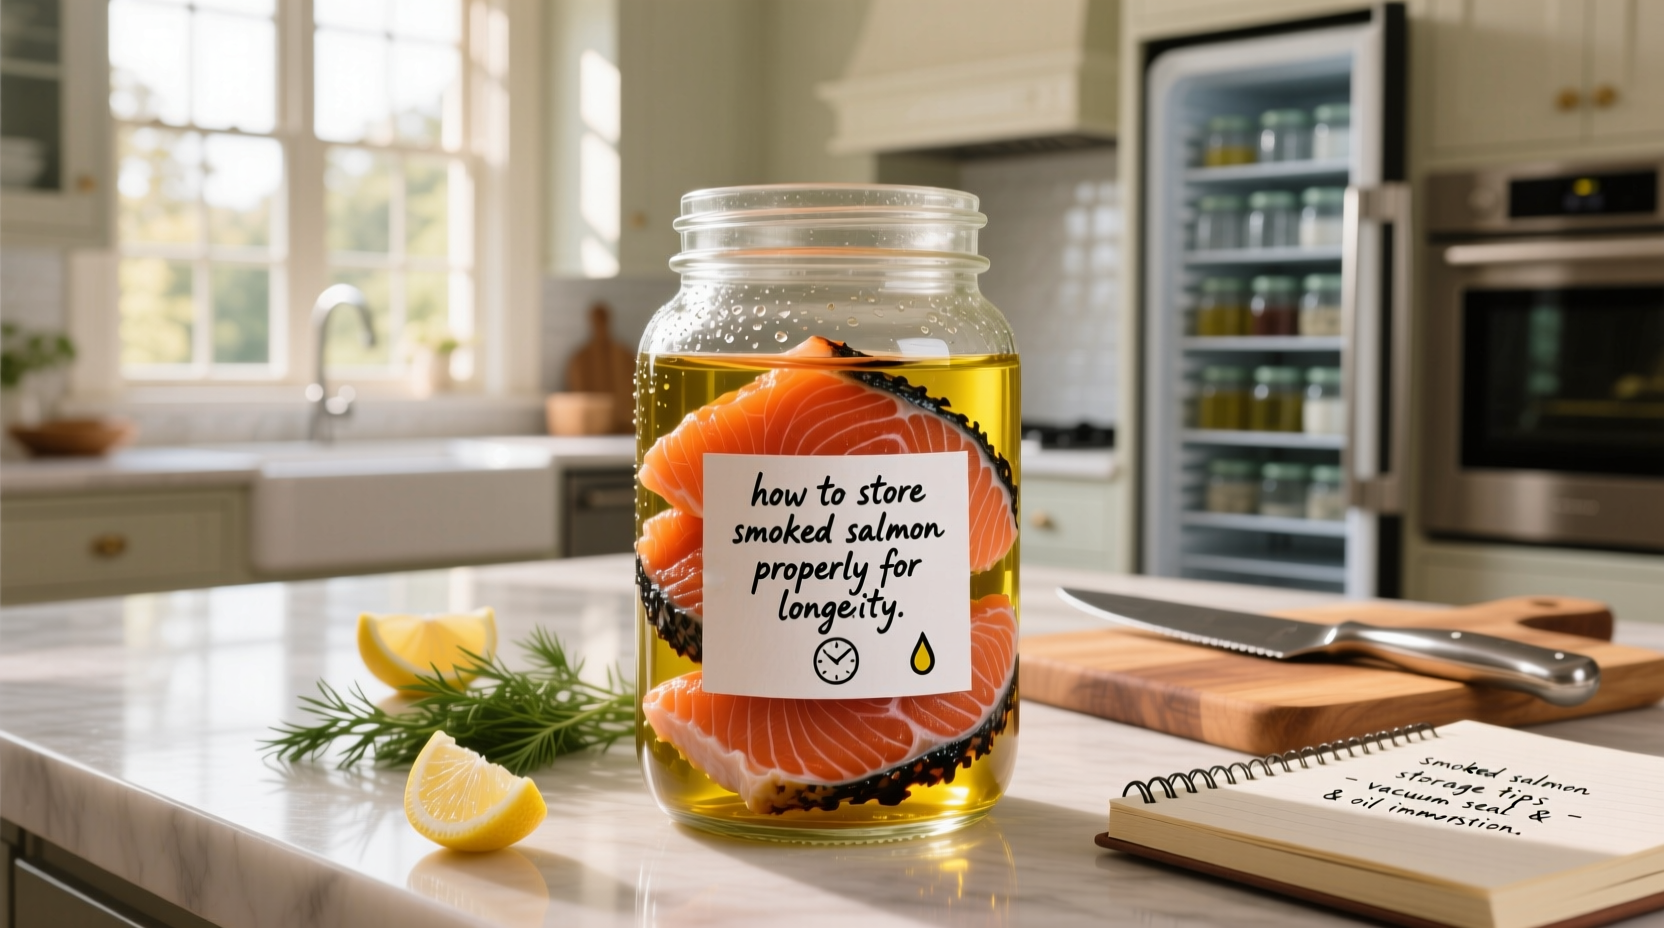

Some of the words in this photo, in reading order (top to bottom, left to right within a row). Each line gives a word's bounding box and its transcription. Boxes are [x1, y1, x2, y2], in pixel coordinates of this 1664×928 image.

[751, 472, 807, 507] how
[817, 475, 846, 506] to
[857, 475, 926, 505] store
[732, 513, 835, 544] smoked
[846, 511, 945, 543] salmon
[751, 551, 869, 596] properly
[880, 547, 922, 588] for
[1396, 770, 1485, 795] storage
[1499, 786, 1549, 811] tips
[1419, 757, 1507, 779] smoked
[1509, 773, 1590, 795] salmon
[1323, 789, 1342, 801] &
[1351, 796, 1381, 809] oil
[1368, 782, 1449, 805] vacuum
[1462, 799, 1515, 816] seal
[1529, 809, 1551, 823] &
